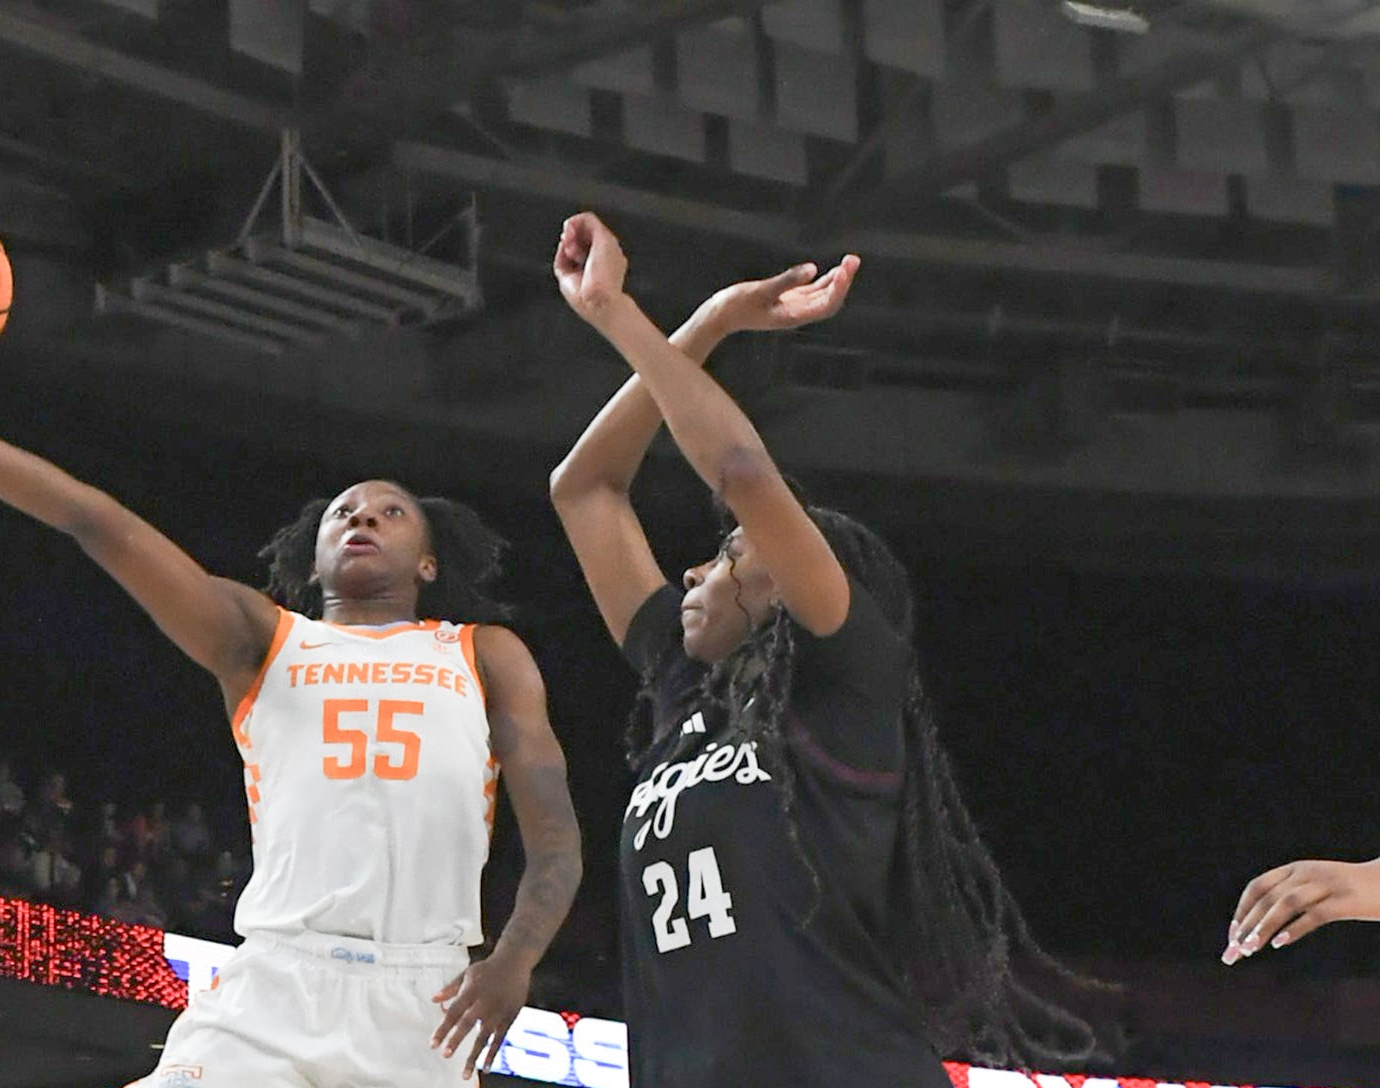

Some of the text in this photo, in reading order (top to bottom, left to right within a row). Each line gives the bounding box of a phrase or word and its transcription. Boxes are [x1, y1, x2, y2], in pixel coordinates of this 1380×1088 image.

[286, 662, 468, 697] TENNESSEE
[323, 698, 424, 781] 55
[642, 846, 737, 953] 24
